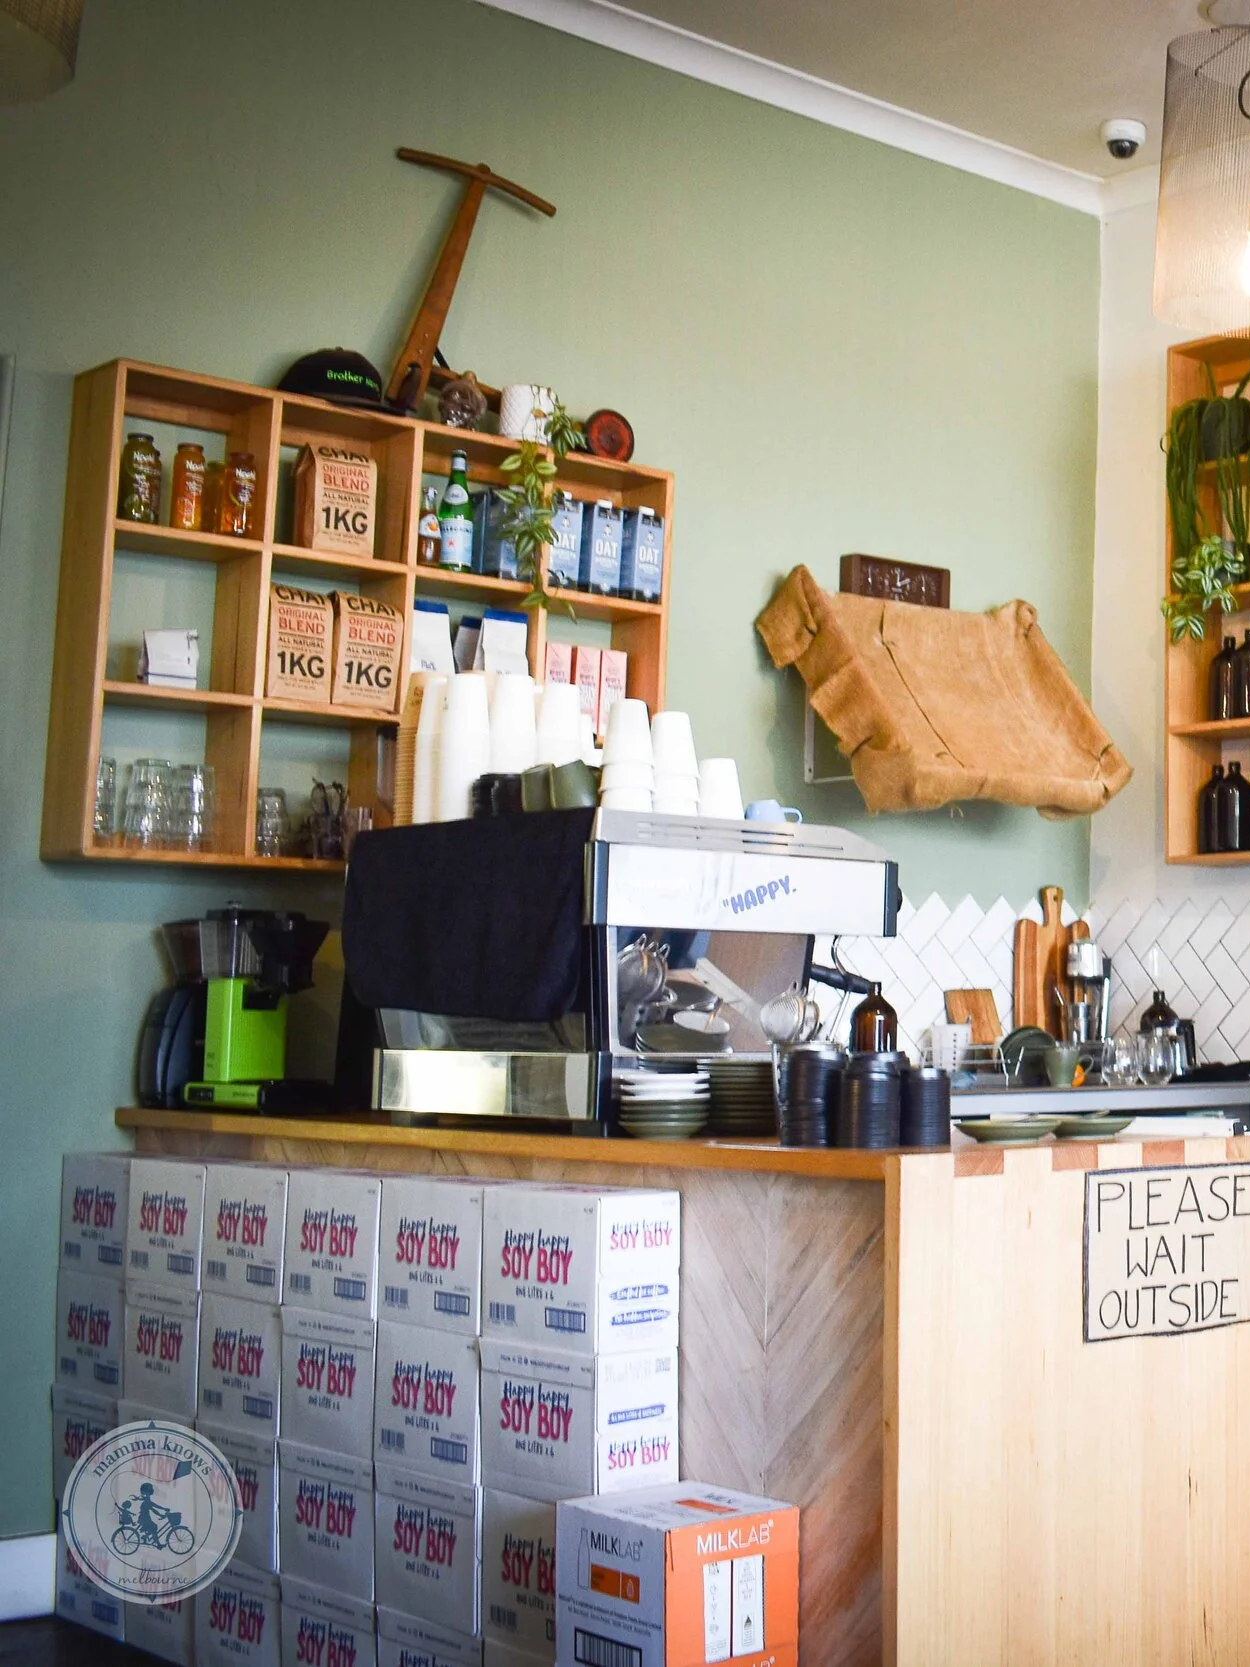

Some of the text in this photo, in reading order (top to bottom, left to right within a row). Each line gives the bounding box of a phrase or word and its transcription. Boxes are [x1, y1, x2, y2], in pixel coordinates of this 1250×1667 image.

[327, 369, 363, 384] Brother
[318, 446, 369, 463] CHAI
[323, 464, 369, 479] ORIGINAL
[323, 474, 370, 492] BLEND
[323, 491, 336, 499] ALL
[337, 493, 369, 505] NATURAL
[322, 505, 368, 535] 1KG
[554, 532, 577, 551] OAT
[595, 539, 618, 558] OAT
[639, 545, 660, 565] OAT
[275, 587, 326, 606] CHAI
[347, 598, 396, 617] CHAI
[278, 607, 325, 621] ORIGINAL
[278, 617, 325, 635] BLEND
[349, 617, 396, 632] ORIGINAL
[278, 636, 292, 645] ALL
[293, 638, 325, 649] NATURAL
[348, 627, 396, 646] BLEND
[277, 651, 325, 679] 1KG
[346, 647, 360, 655] ALL
[361, 648, 393, 660] NATURAL
[344, 661, 392, 689] 1KG
[73, 1196, 116, 1229] SOY BOY
[139, 1204, 188, 1236] SOY BOY
[304, 1207, 356, 1230] Happy happy
[217, 1212, 268, 1247] SOY BOY
[301, 1222, 358, 1258] SOY BOY
[400, 1216, 457, 1242] Happy happy
[504, 1228, 569, 1257] Happy happy
[610, 1228, 672, 1251] SOY BOY
[396, 1231, 460, 1270] SOY BOY
[1126, 1233, 1215, 1279] WAIT
[501, 1245, 573, 1285] SOY BOY
[1099, 1279, 1239, 1330] OUTSIDE
[67, 1313, 111, 1347] SOY BOY
[137, 1327, 183, 1362] SOY BOY
[212, 1339, 264, 1378] SOY BOY
[301, 1343, 354, 1366] Happy happy
[297, 1358, 357, 1398] SOY BOY
[395, 1360, 453, 1384] Happy happy
[392, 1375, 456, 1417] SOY BOY
[503, 1380, 569, 1408] Happy happy
[501, 1397, 534, 1435] SOY
[537, 1402, 573, 1443] BOY
[608, 1441, 670, 1470] SOY BOY
[299, 1479, 354, 1505] Happy happy
[296, 1495, 357, 1539] SOY BOY
[397, 1504, 454, 1532] Happy happy
[393, 1519, 457, 1568] SOY BOY
[504, 1532, 534, 1555] Happy
[590, 1530, 642, 1561] MILKLAB
[696, 1523, 771, 1555] MILKLAB
[502, 1548, 534, 1589] SOY
[209, 1600, 236, 1635] SOY
[238, 1606, 265, 1645] BOY
[297, 1632, 357, 1667] SOY BOY
